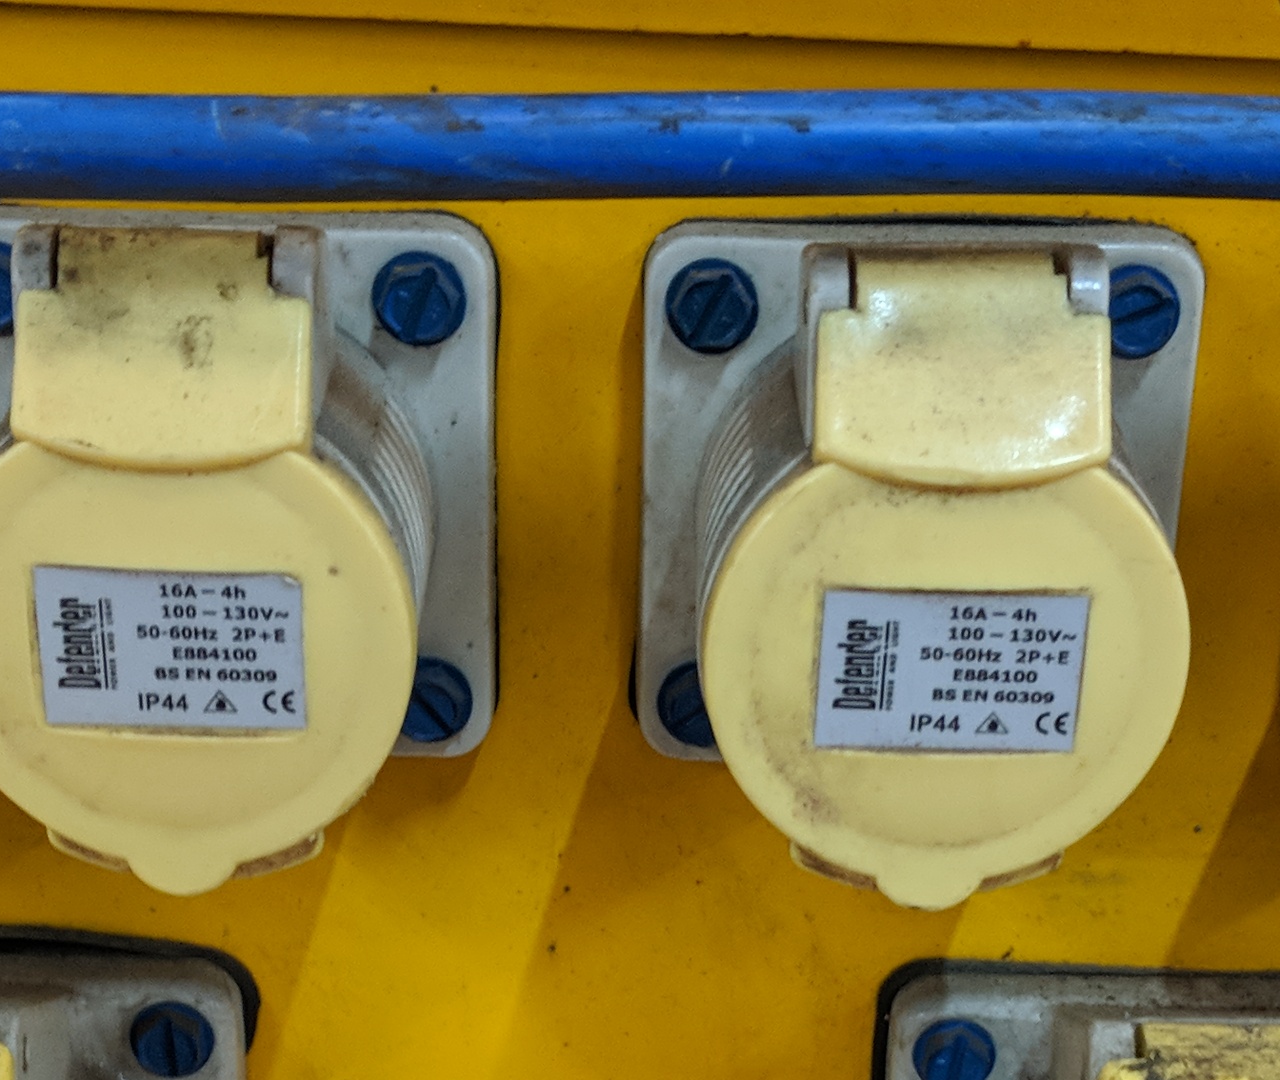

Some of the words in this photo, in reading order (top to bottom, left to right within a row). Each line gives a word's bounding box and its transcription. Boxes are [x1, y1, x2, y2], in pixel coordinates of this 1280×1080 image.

[159, 585, 196, 598] 16A
[222, 586, 246, 599] 4h
[162, 605, 196, 618] 100
[950, 607, 986, 621] 16A
[1012, 608, 1036, 622] 4h
[137, 626, 218, 640] 50-60Hz
[948, 628, 983, 640] 100
[173, 648, 256, 660] E884100
[920, 648, 1002, 663] 50-60Hz
[155, 668, 179, 680] BS
[186, 669, 210, 680] EN
[217, 669, 277, 682] 60309
[953, 670, 1037, 683] E884100
[138, 693, 188, 711] IP44
[932, 690, 956, 700] BS
[962, 690, 988, 702] EN
[994, 691, 1054, 703] 60309
[910, 715, 960, 732] IP44
